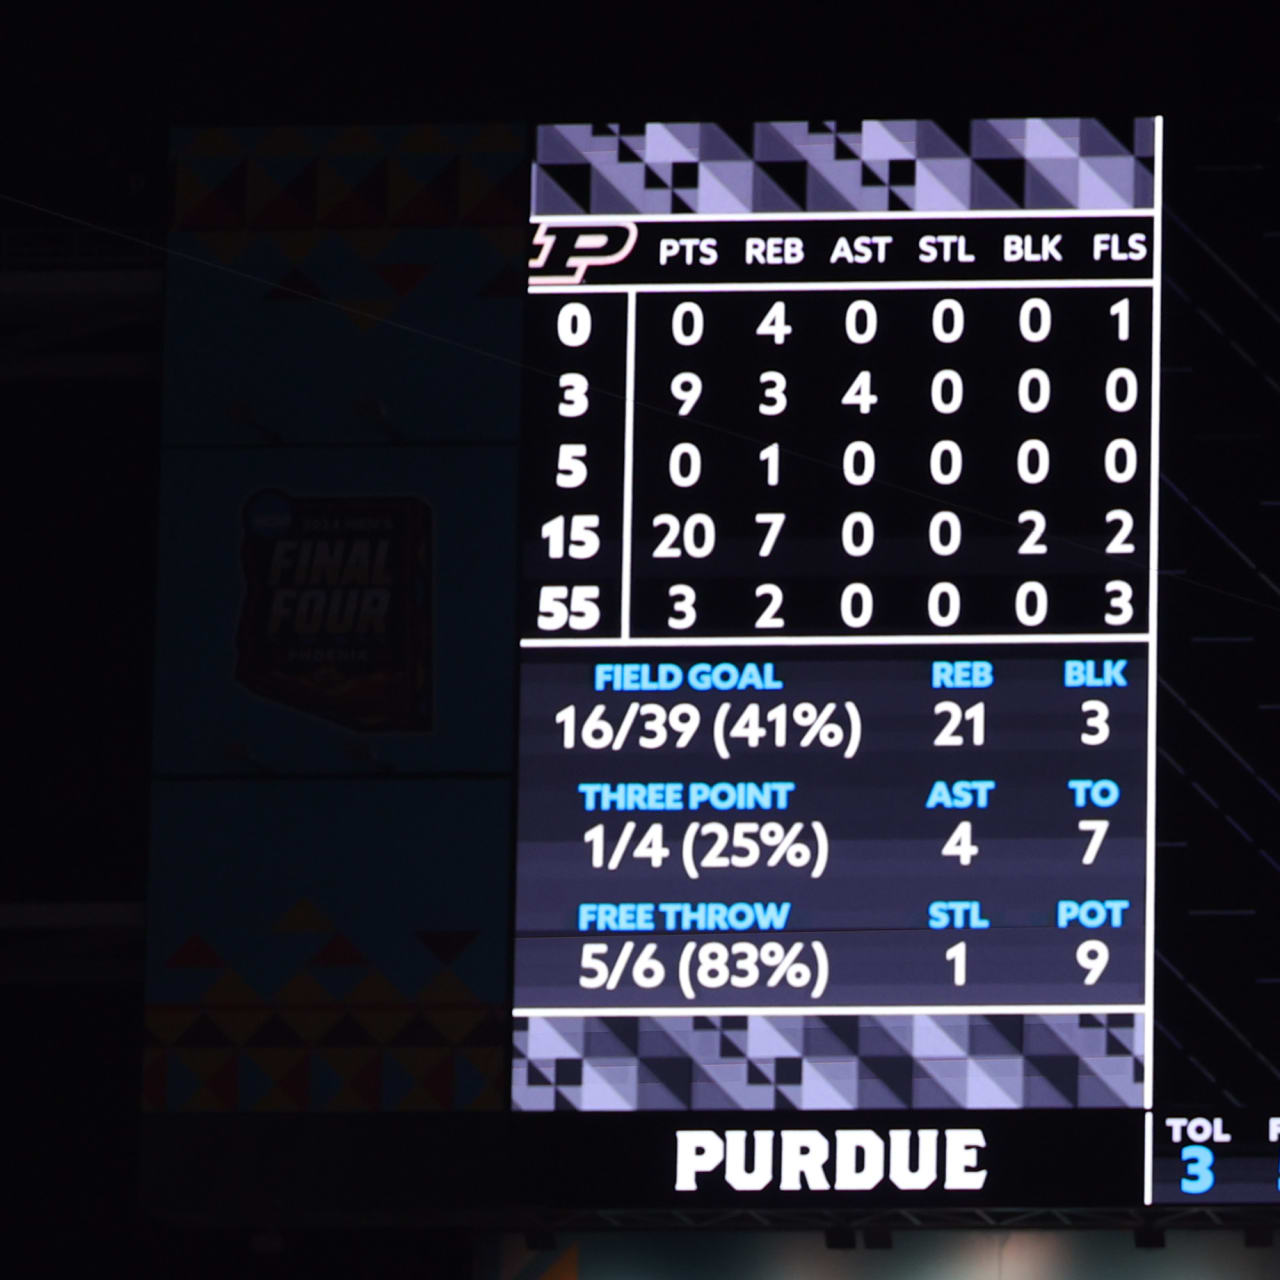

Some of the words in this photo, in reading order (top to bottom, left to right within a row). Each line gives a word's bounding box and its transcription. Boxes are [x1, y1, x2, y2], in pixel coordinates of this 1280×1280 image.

[659, 237, 719, 266] PTS
[745, 237, 805, 265] REB
[829, 235, 894, 264] AST
[918, 235, 976, 263] STL
[1003, 234, 1063, 262] BLK
[1093, 232, 1148, 261] FLS
[541, 514, 600, 560] 15
[652, 513, 716, 558] 20
[755, 512, 786, 558] 7
[841, 511, 875, 557] 0
[928, 510, 962, 557] 0
[1017, 509, 1048, 555] 2
[1105, 508, 1136, 554] 2
[594, 663, 685, 692] FIELD
[686, 662, 785, 692] GOAL
[931, 660, 995, 689] REB
[1063, 659, 1129, 688] BLK
[555, 702, 701, 751] 16/39
[713, 701, 862, 760] (41%)
[933, 700, 985, 747] 21
[1080, 699, 1110, 746] 3
[577, 782, 685, 812] THREE
[687, 781, 797, 811] POINT
[925, 780, 996, 810] AST
[1068, 779, 1120, 808] TO
[583, 821, 670, 871] 1/4
[682, 820, 829, 880] (25%)
[941, 820, 979, 866] 4
[1078, 819, 1110, 866] 7
[577, 902, 657, 932] FREE
[657, 901, 792, 932] THROW
[927, 900, 991, 931] STL
[1056, 899, 1131, 929] POT
[578, 940, 666, 991] 5/6
[678, 940, 829, 1000] (83%)
[945, 941, 967, 987] 1
[1075, 939, 1110, 986] 9
[1165, 1117, 1232, 1143] TOL
[674, 1128, 988, 1191] PURDUE
[1180, 1144, 1215, 1195] 3
